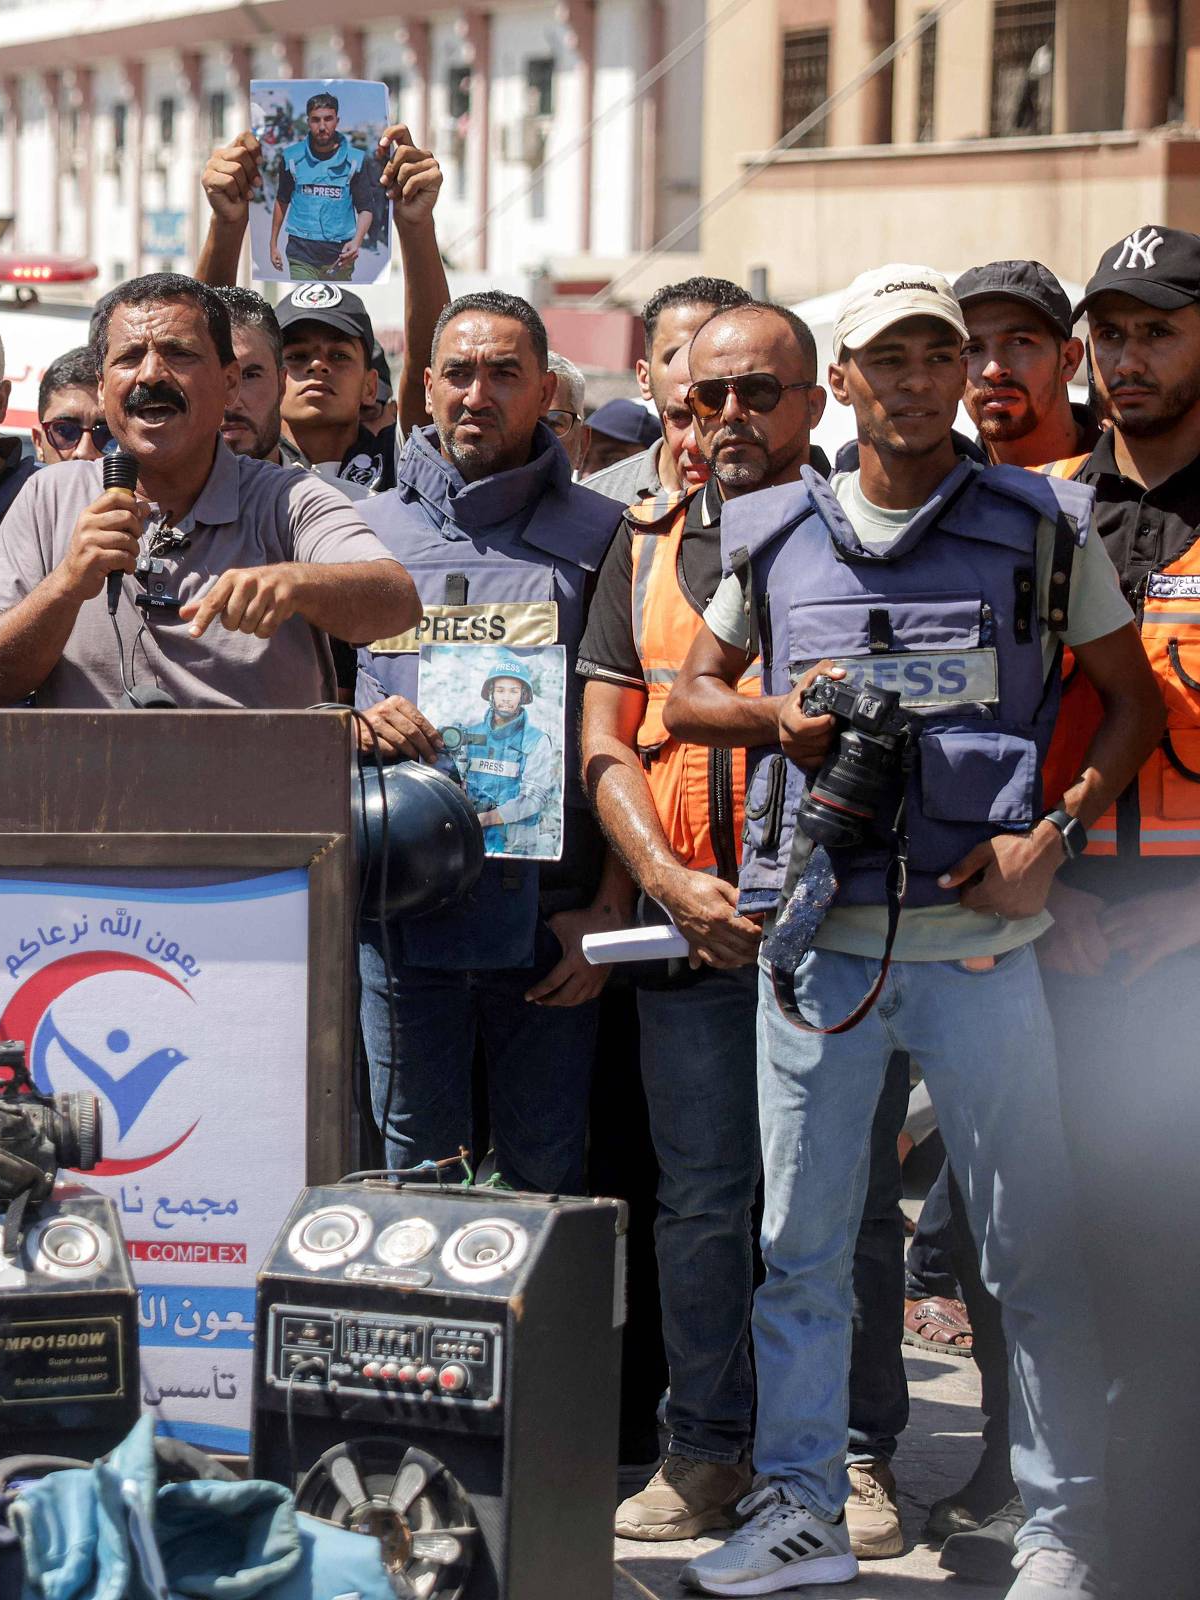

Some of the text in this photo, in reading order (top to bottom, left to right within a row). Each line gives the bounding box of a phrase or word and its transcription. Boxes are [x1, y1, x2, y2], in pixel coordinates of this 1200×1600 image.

[313, 186, 341, 197] PRESS
[1112, 228, 1164, 270] NY
[885, 281, 939, 294] Columbia
[415, 615, 506, 641] PRESS
[495, 663, 520, 673] PRESS
[843, 658, 968, 697] RESS
[479, 760, 505, 773] PRESS
[145, 931, 202, 982] بعون
[120, 1185, 239, 1229] مجمع نا
[147, 1244, 244, 1263] COMPLEX
[48, 1357, 72, 1366] Super
[71, 1374, 88, 1382] USB
[89, 1372, 108, 1381] MP3
